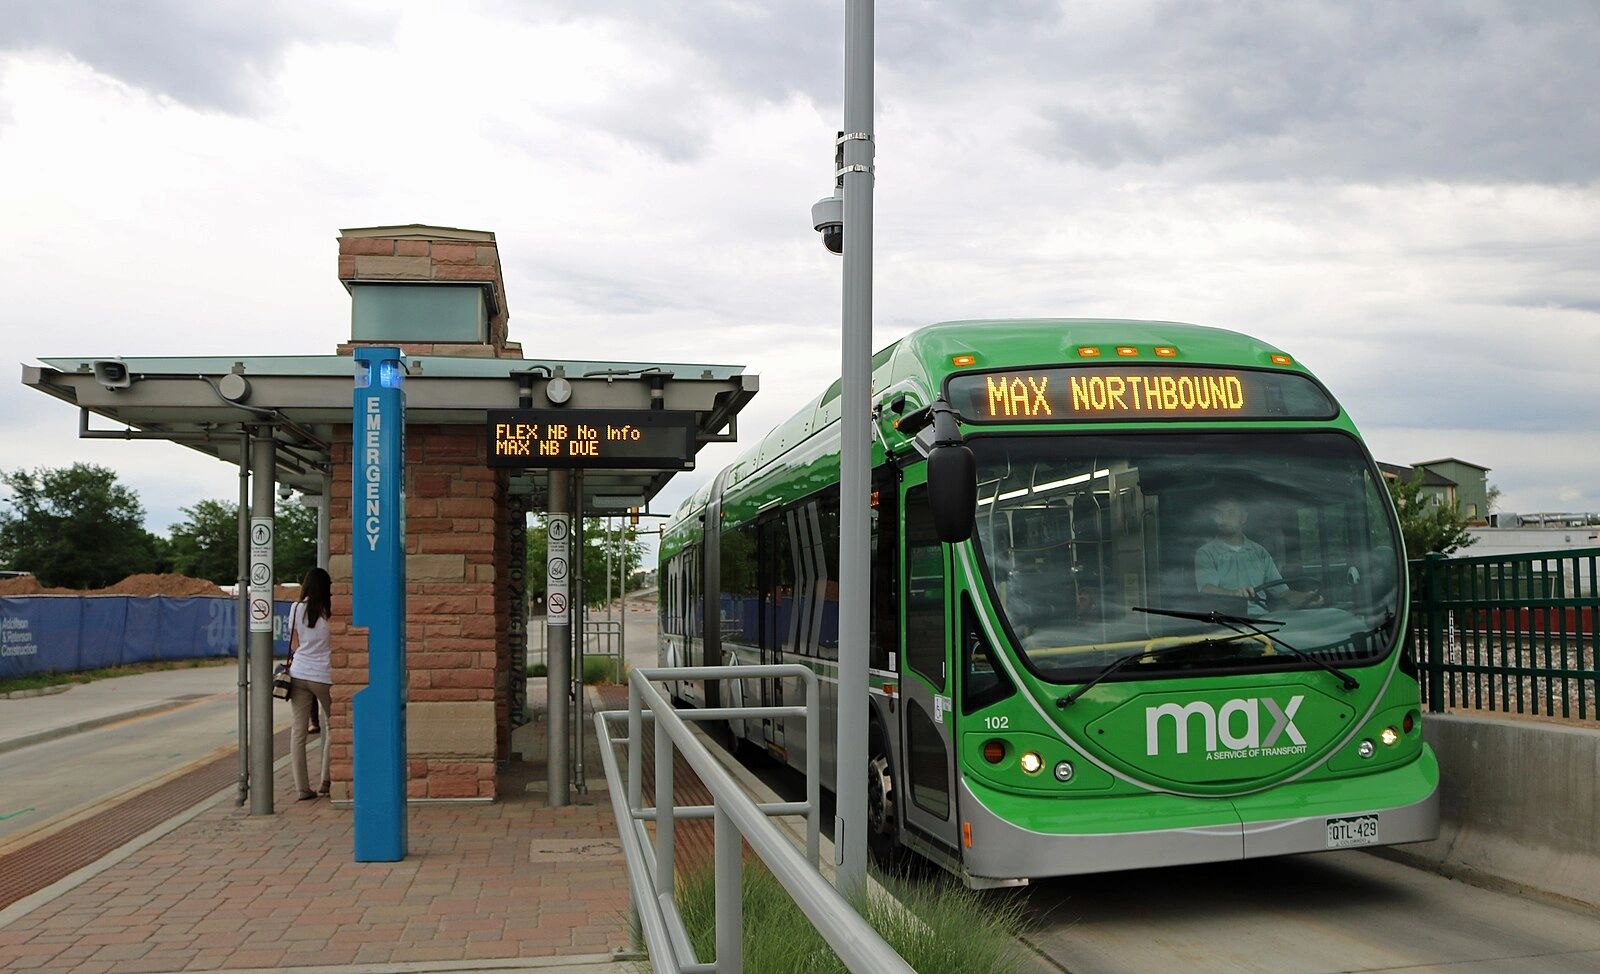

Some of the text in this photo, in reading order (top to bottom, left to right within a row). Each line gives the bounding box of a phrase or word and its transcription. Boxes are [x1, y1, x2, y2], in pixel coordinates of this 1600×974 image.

[987, 376, 1244, 416] MAX NORTHBOUND
[495, 424, 641, 441] FLEX NB No Info
[495, 440, 599, 456] MAX NB DUE
[365, 396, 381, 551] EMERGENCY
[984, 716, 1009, 729] 102
[1146, 695, 1307, 756] max
[1206, 745, 1307, 761] A SERVICE OF TRANSFORT
